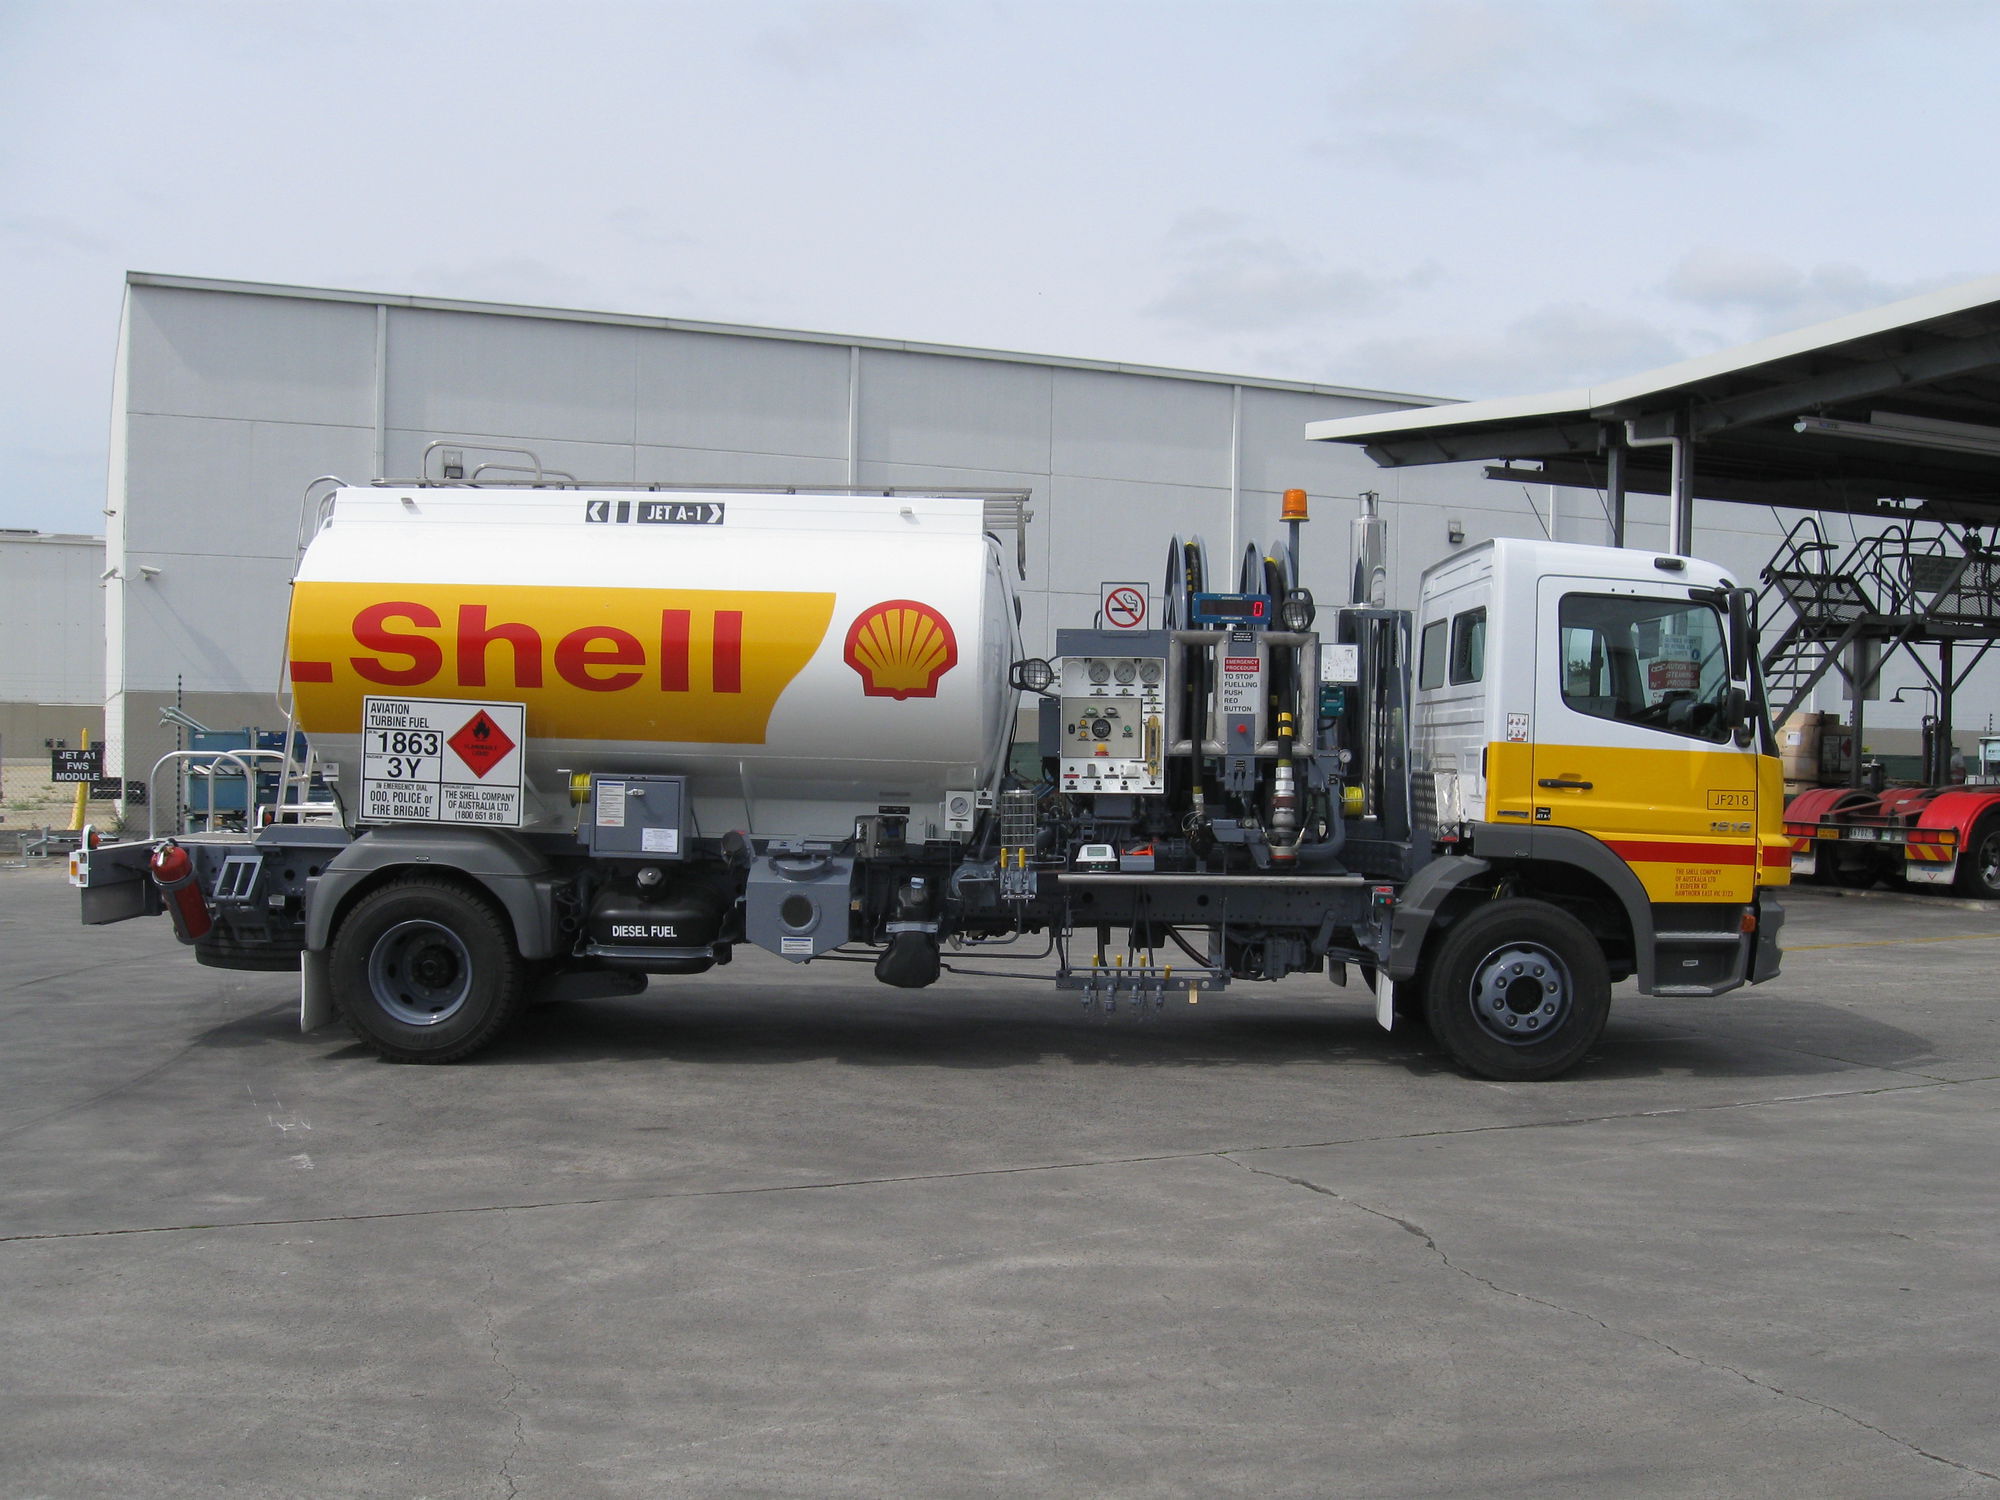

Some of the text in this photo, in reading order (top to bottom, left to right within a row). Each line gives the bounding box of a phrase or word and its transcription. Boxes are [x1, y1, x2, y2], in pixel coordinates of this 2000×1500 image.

[647, 504, 702, 521] JET A-1
[1253, 601, 1263, 616] 0
[349, 601, 743, 694] Shell
[370, 702, 410, 715] AVIATION
[370, 715, 430, 729] TURBINE FUEL
[378, 731, 439, 756] 1863
[59, 751, 96, 760] JET A1
[66, 761, 90, 770] FWS
[387, 756, 422, 779] 3Y
[56, 772, 100, 781] MODULE
[383, 782, 415, 791] EMERGENCY
[415, 784, 428, 792] DIAL
[392, 791, 422, 804] POLICE
[424, 795, 433, 804] or
[445, 790, 515, 803] THE SHELL COMPANY
[1714, 795, 1749, 806] JF218
[372, 804, 431, 818] FIRE BRIGADE
[448, 800, 511, 812] OF AUSTRALIA LTD.
[454, 810, 504, 823] (1800 651 818)
[1711, 822, 1752, 832] 1818
[612, 925, 677, 938] DIESEL FUEL
